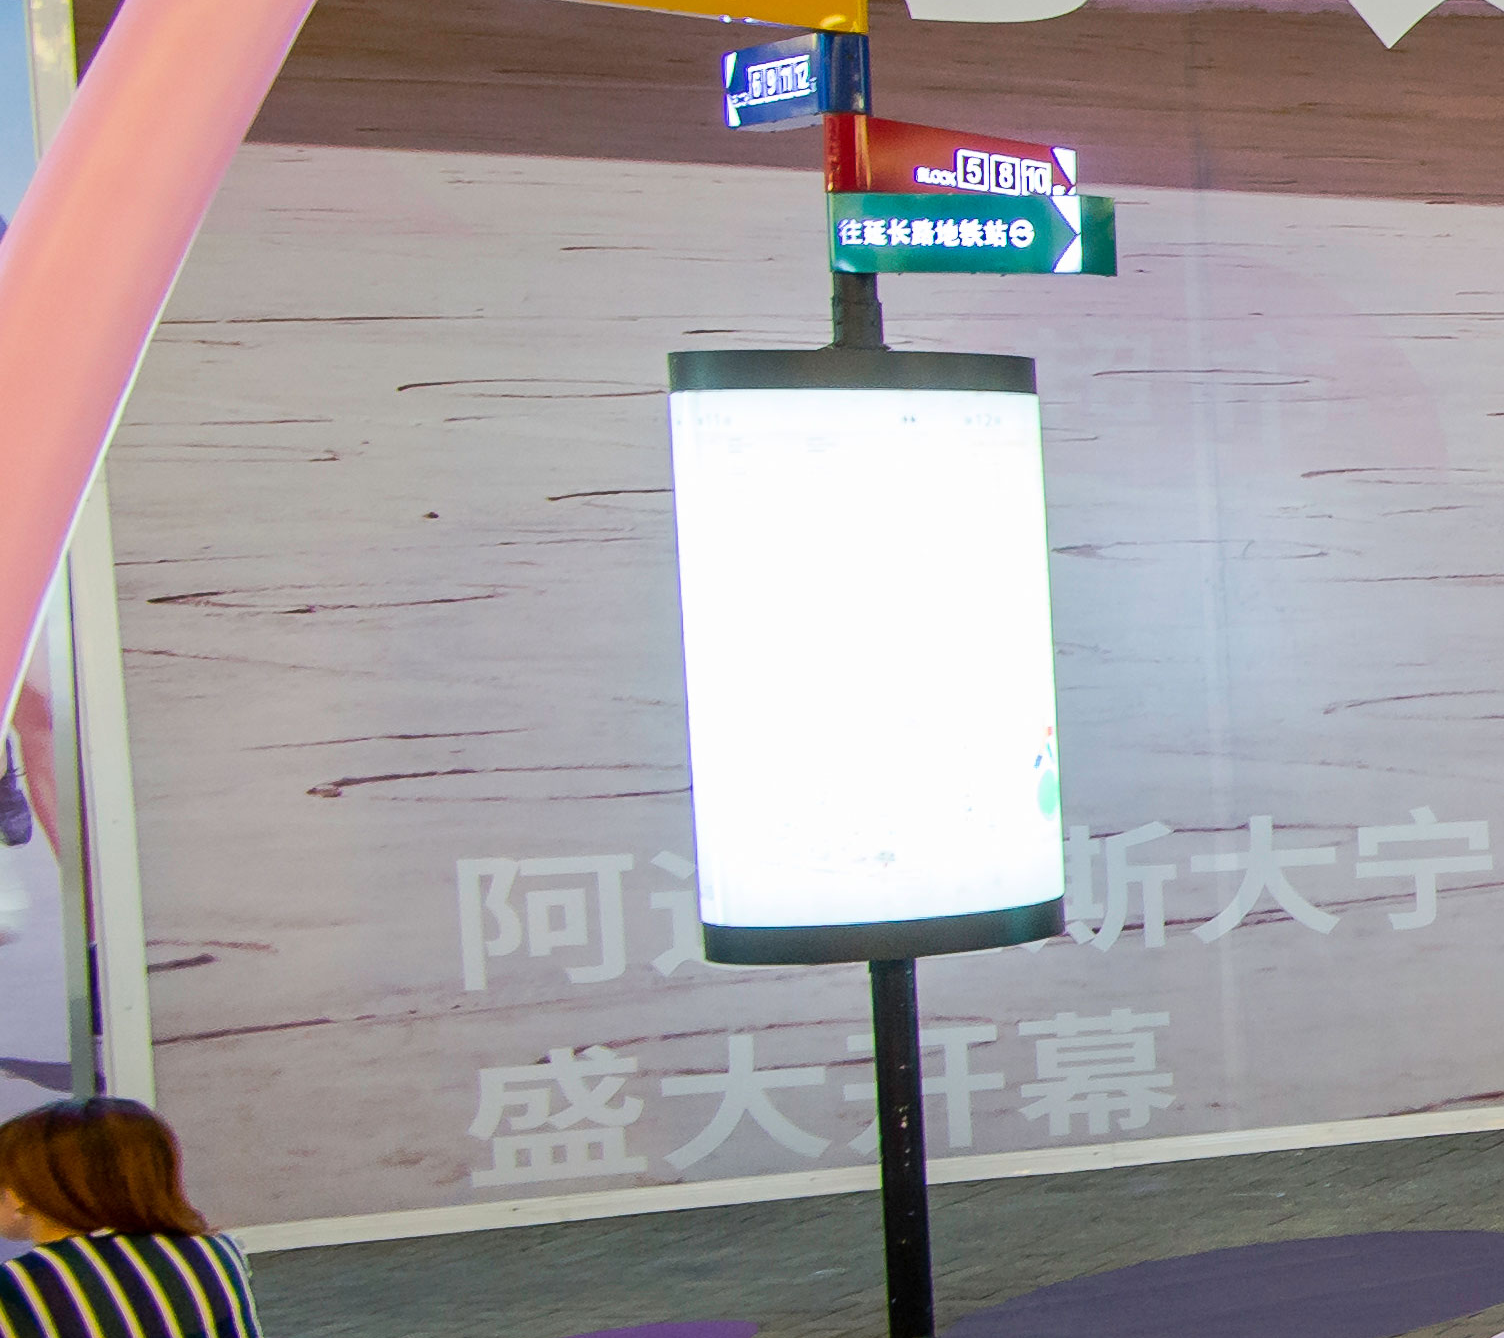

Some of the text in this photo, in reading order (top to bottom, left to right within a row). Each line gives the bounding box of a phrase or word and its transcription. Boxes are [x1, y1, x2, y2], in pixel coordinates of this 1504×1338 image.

[837, 217, 1009, 248] 往延长路地铁站
[469, 1007, 1177, 1190] 盛大开幕
